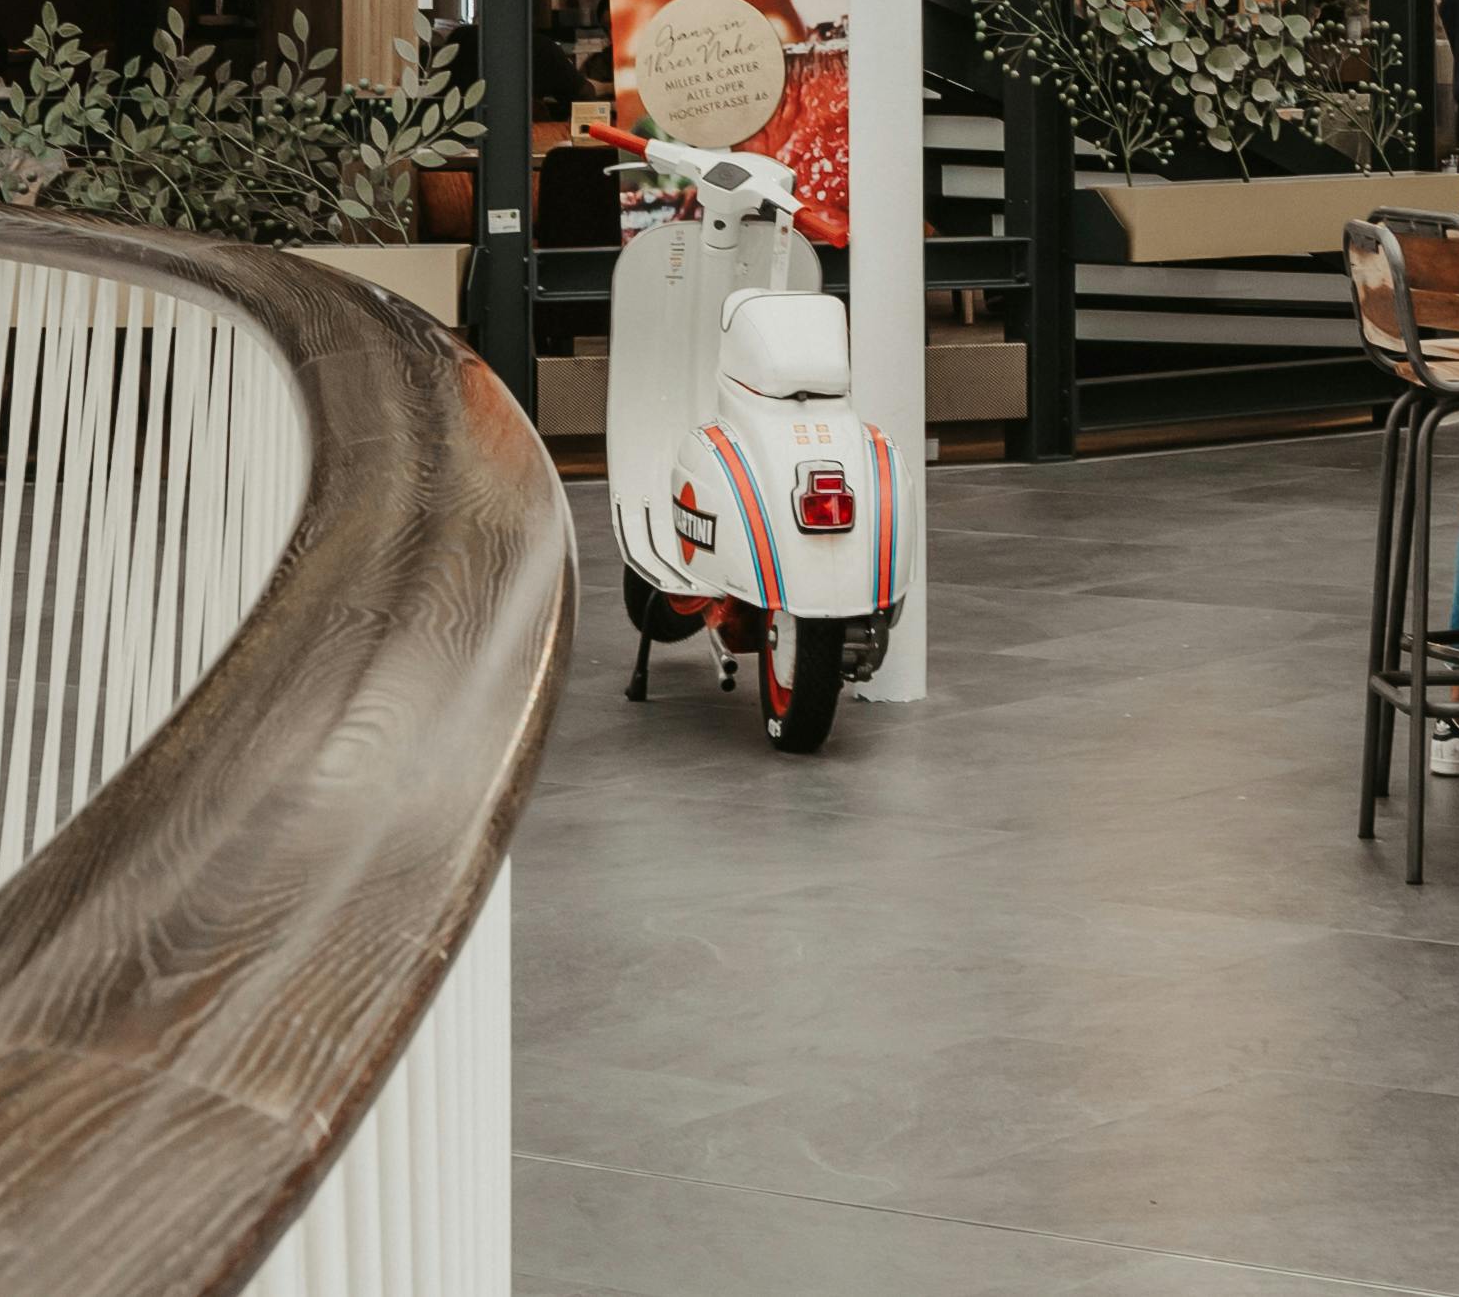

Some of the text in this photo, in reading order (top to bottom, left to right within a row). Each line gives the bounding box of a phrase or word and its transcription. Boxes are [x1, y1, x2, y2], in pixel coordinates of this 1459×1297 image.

[665, 61, 760, 91] MILLER & CARTER
[686, 80, 745, 102] ALTE OPER
